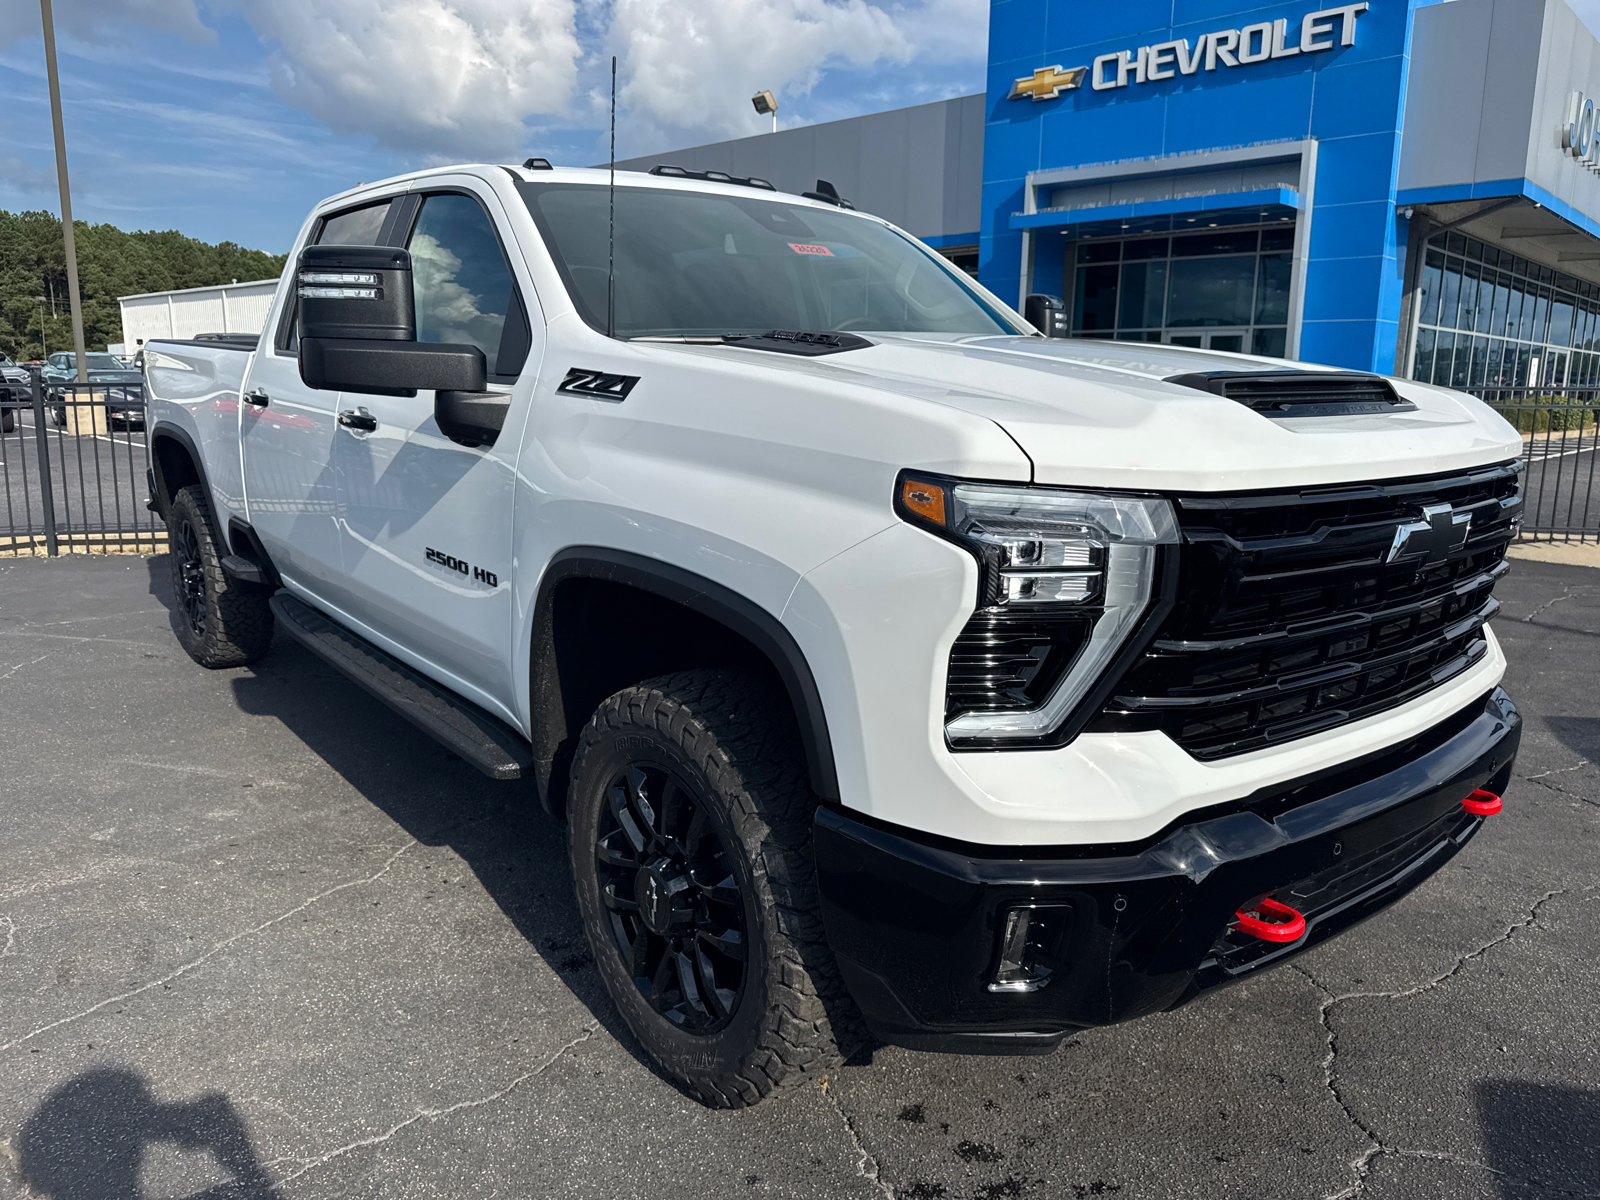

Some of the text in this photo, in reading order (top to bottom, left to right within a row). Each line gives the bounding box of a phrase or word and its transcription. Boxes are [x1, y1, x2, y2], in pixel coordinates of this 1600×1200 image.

[1092, 2, 1369, 91] CHEVROLET
[555, 367, 641, 404] Z71
[425, 546, 498, 588] 2500 HD
